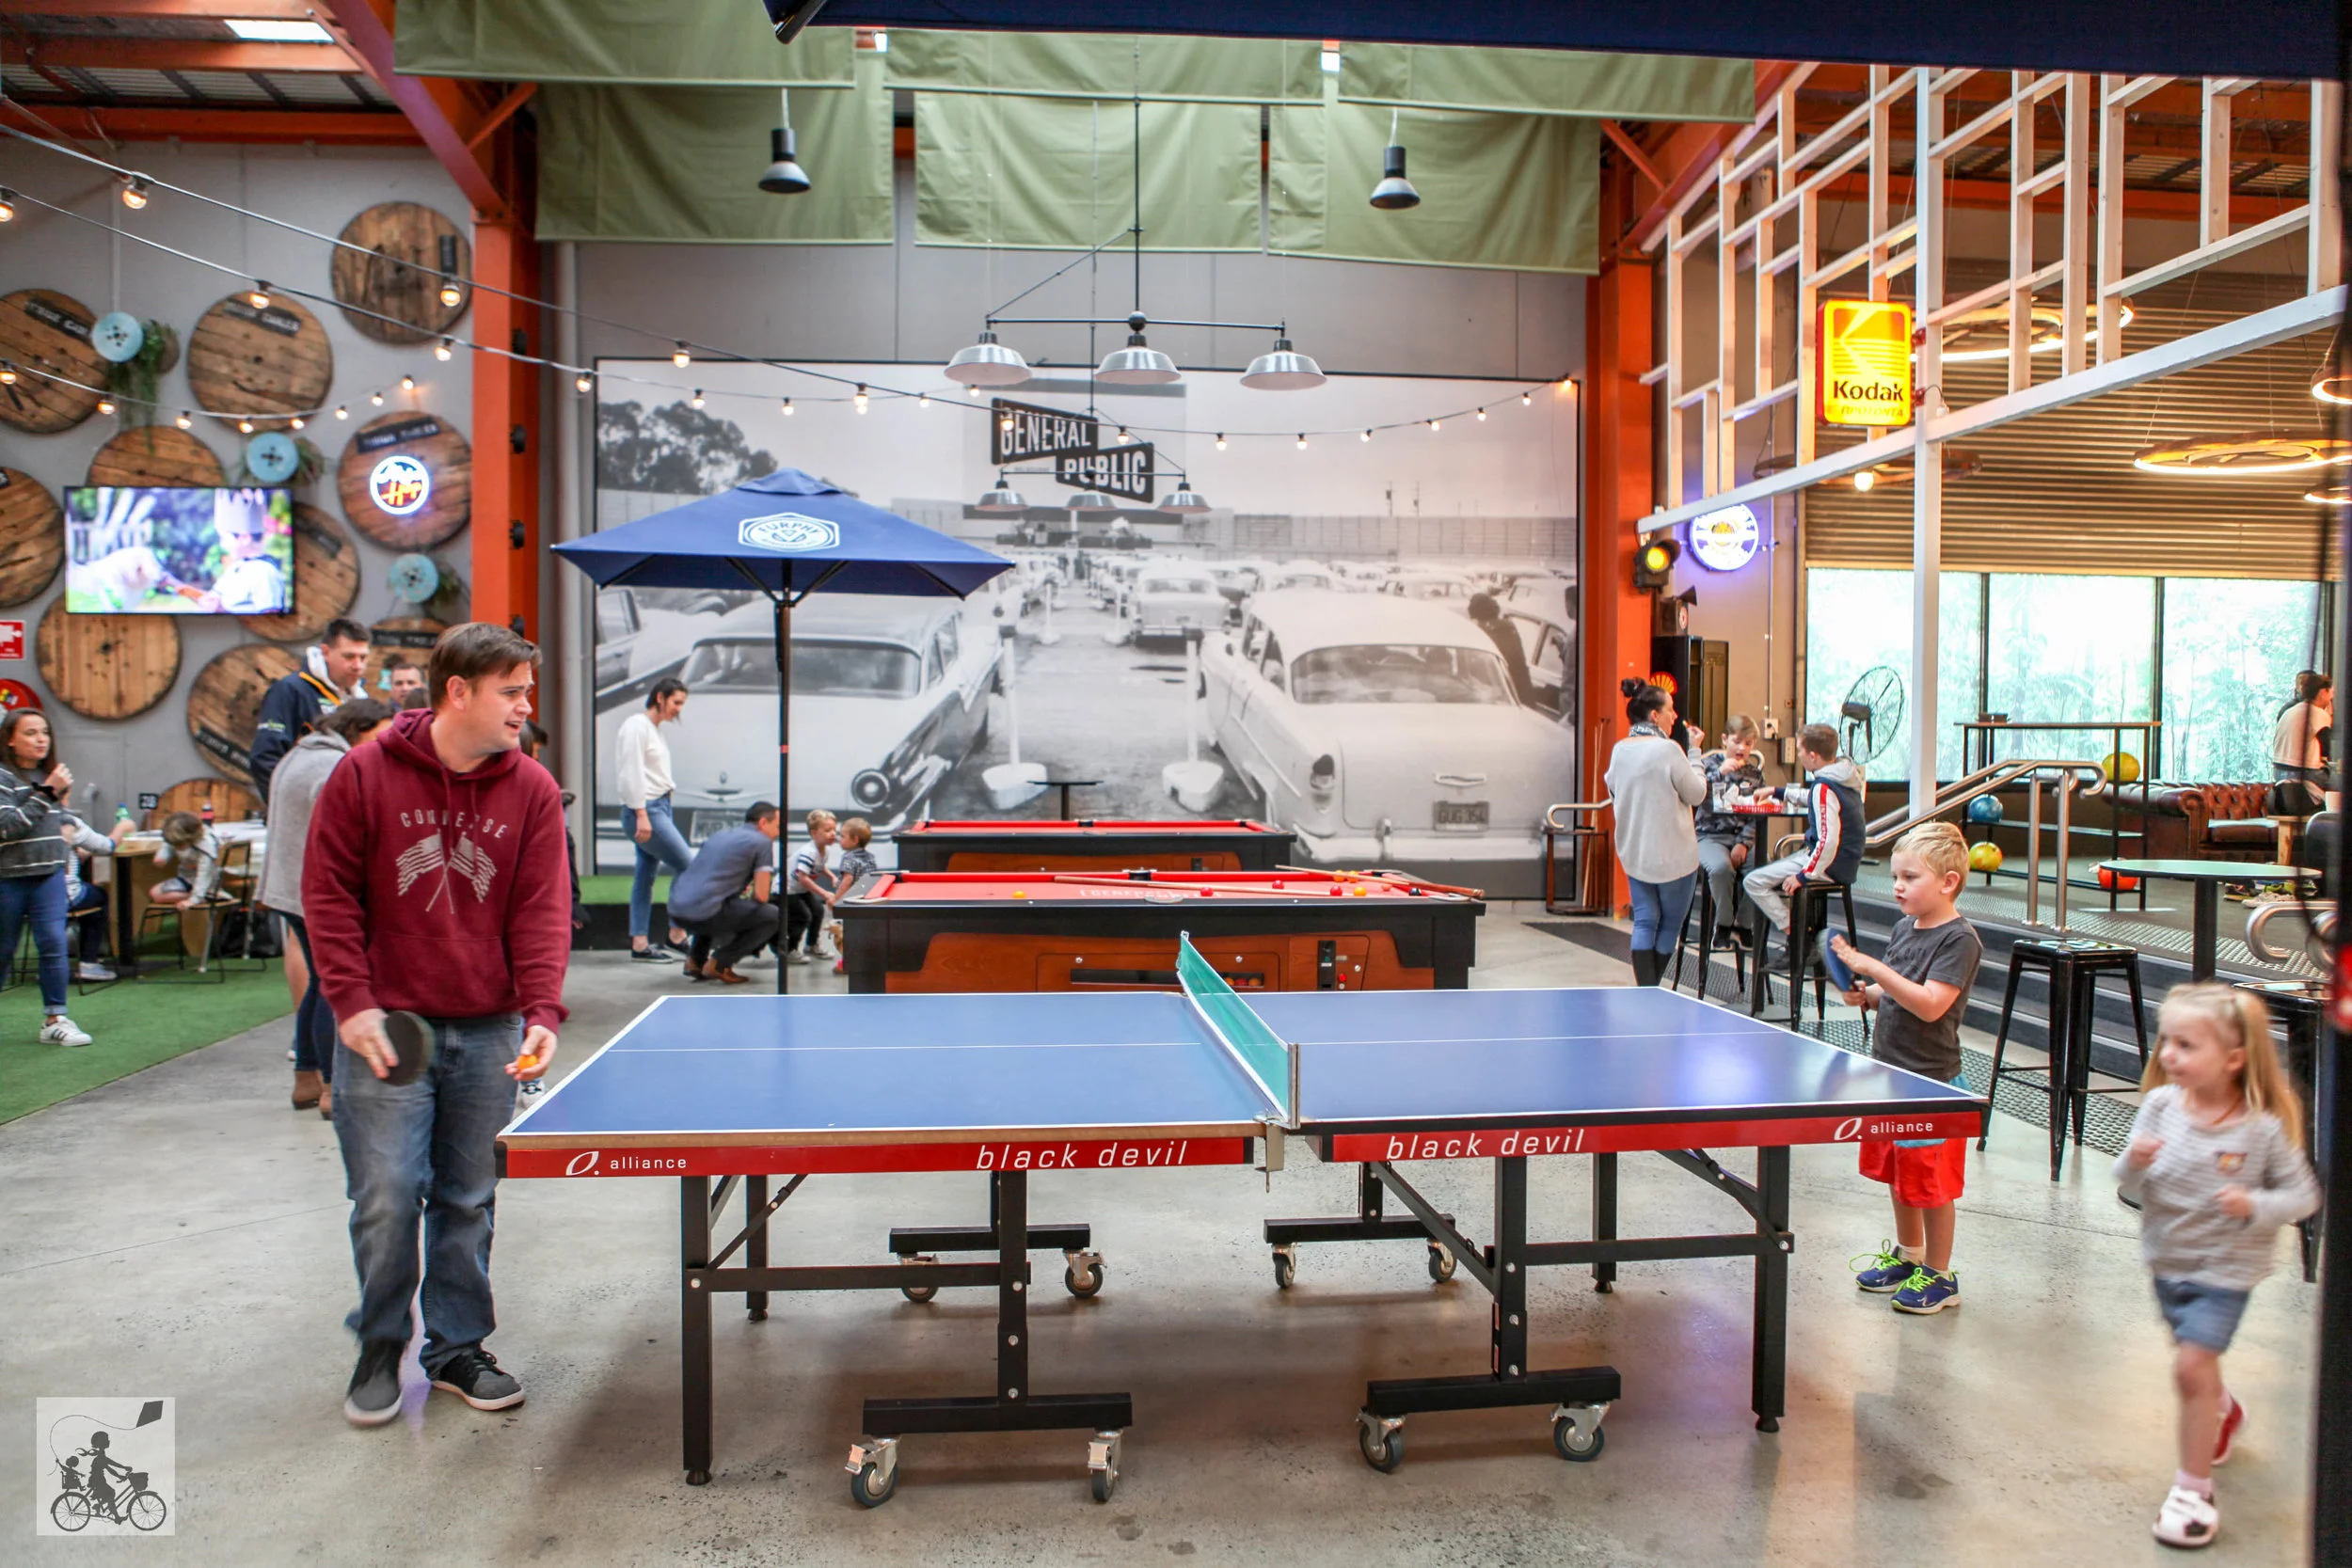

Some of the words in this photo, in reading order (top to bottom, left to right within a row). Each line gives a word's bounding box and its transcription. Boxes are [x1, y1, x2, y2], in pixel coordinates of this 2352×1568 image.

[1834, 381, 1903, 402] Kodak
[1000, 407, 1091, 456] GENERAL
[1064, 451, 1146, 495] PUBLIC
[400, 809, 507, 838] CONESE
[1870, 1121, 1933, 1133] alliance
[977, 1143, 1077, 1169] black
[1098, 1140, 1187, 1166] devil
[1386, 1132, 1482, 1160] black
[1501, 1129, 1584, 1155] devil
[611, 1156, 687, 1169] alliance
